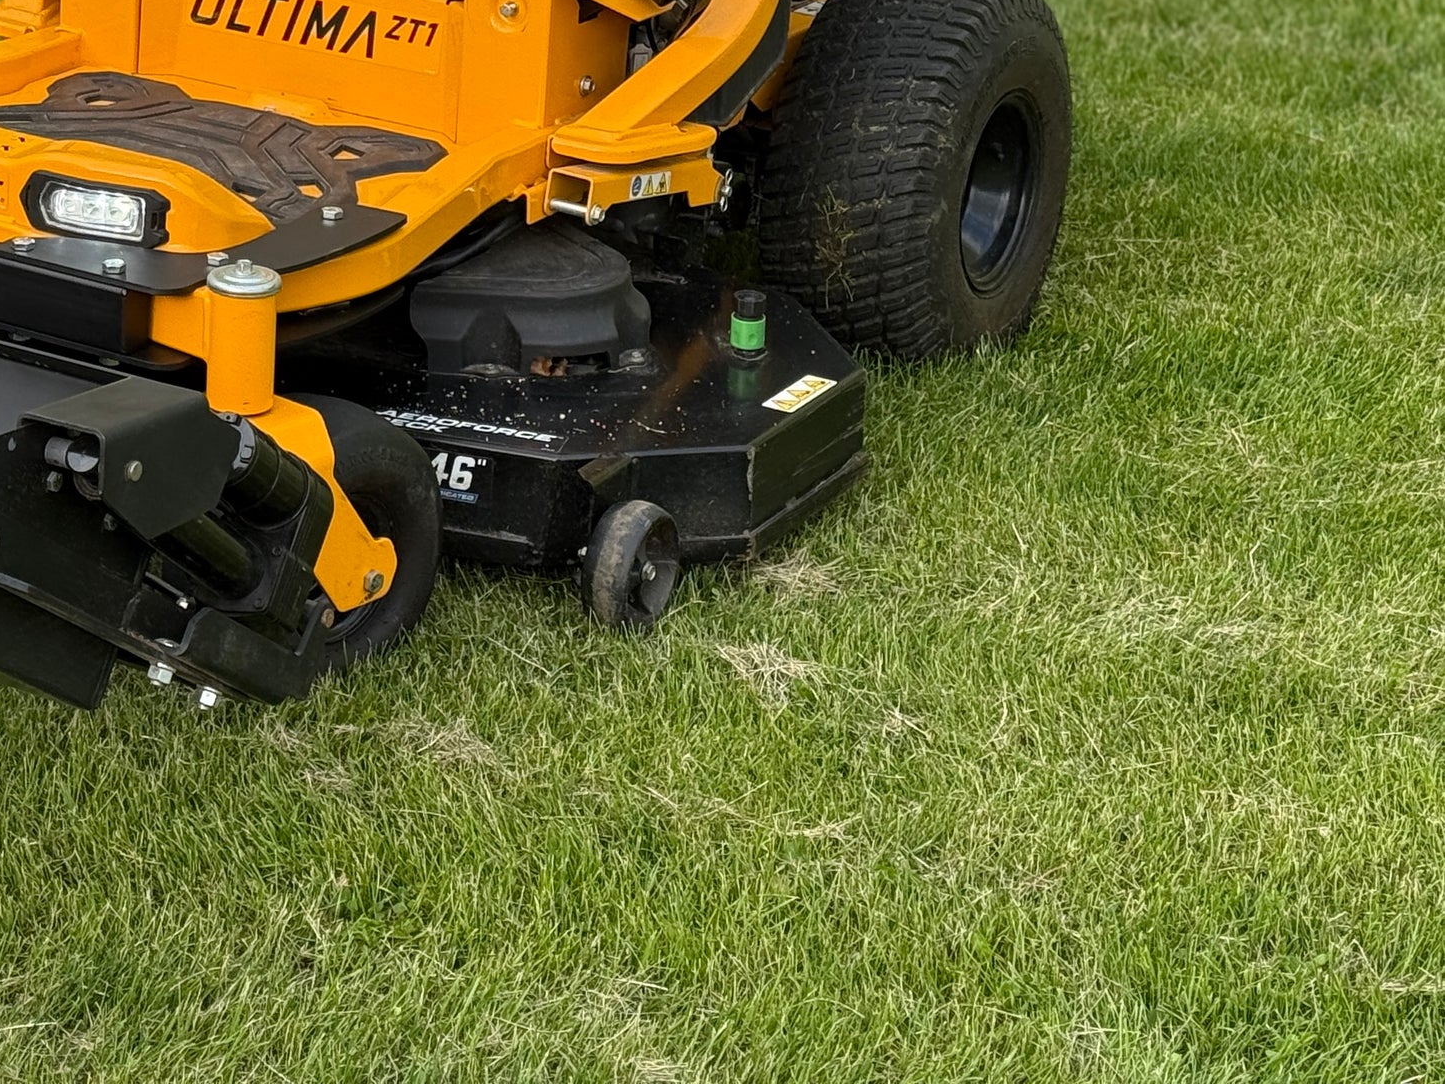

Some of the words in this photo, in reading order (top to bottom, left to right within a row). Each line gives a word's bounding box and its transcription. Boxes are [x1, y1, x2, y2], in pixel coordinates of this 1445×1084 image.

[384, 15, 439, 47] ZT1
[376, 410, 559, 442] AEROFORCE
[384, 417, 449, 433] ECK
